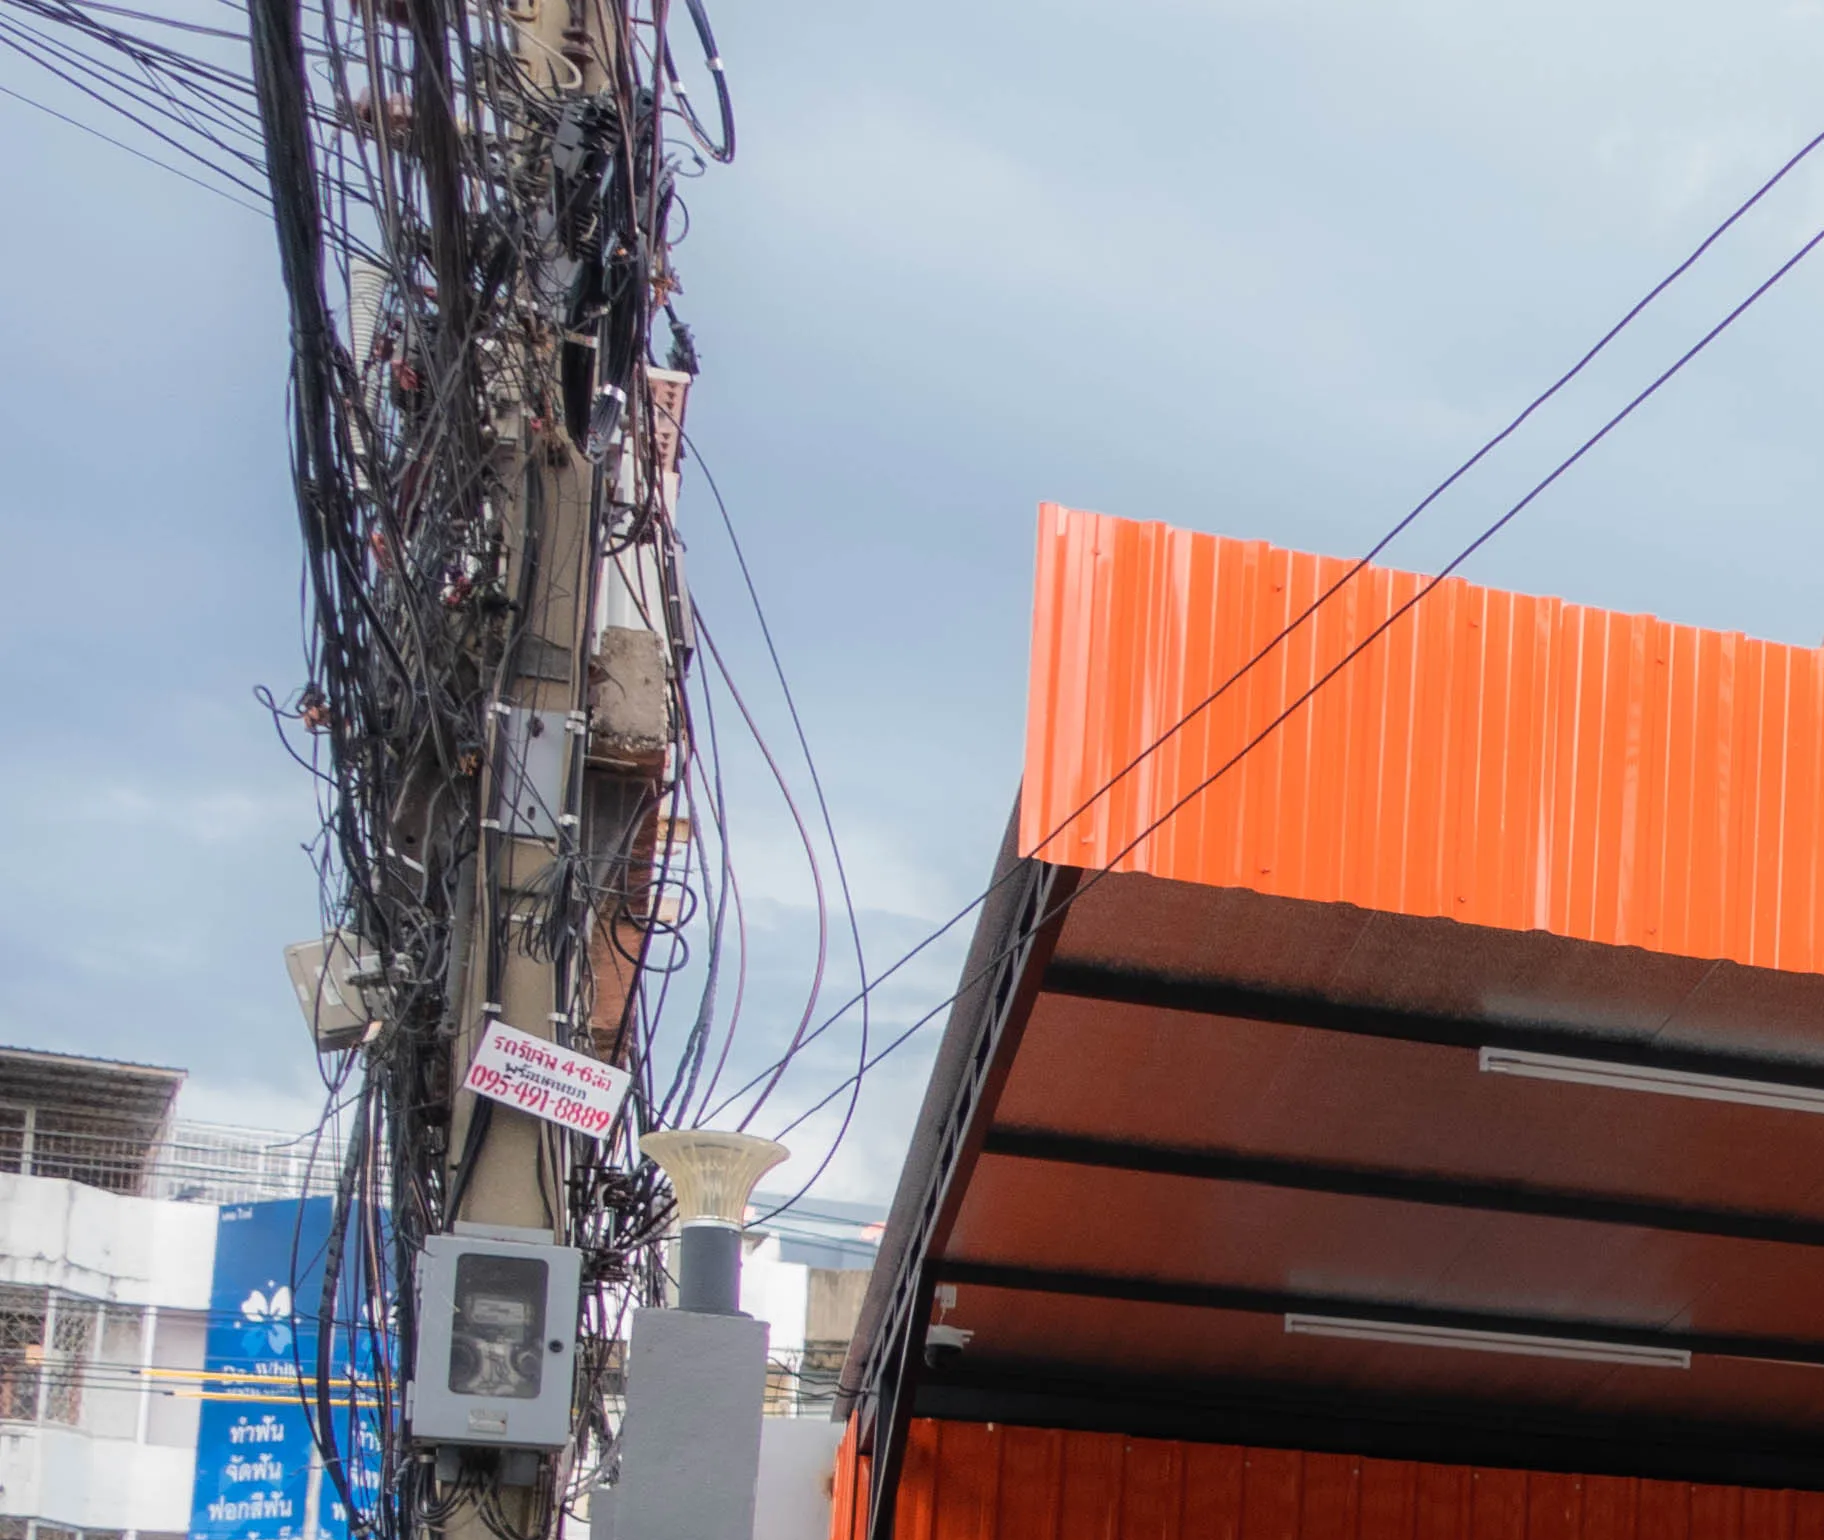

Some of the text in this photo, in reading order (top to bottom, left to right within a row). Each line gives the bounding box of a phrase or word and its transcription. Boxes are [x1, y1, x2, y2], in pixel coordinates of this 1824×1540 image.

[469, 1064, 611, 1132] 095-491-8889
[230, 1416, 285, 1444] ทำฟัน
[225, 1453, 283, 1483] จัดฟัน
